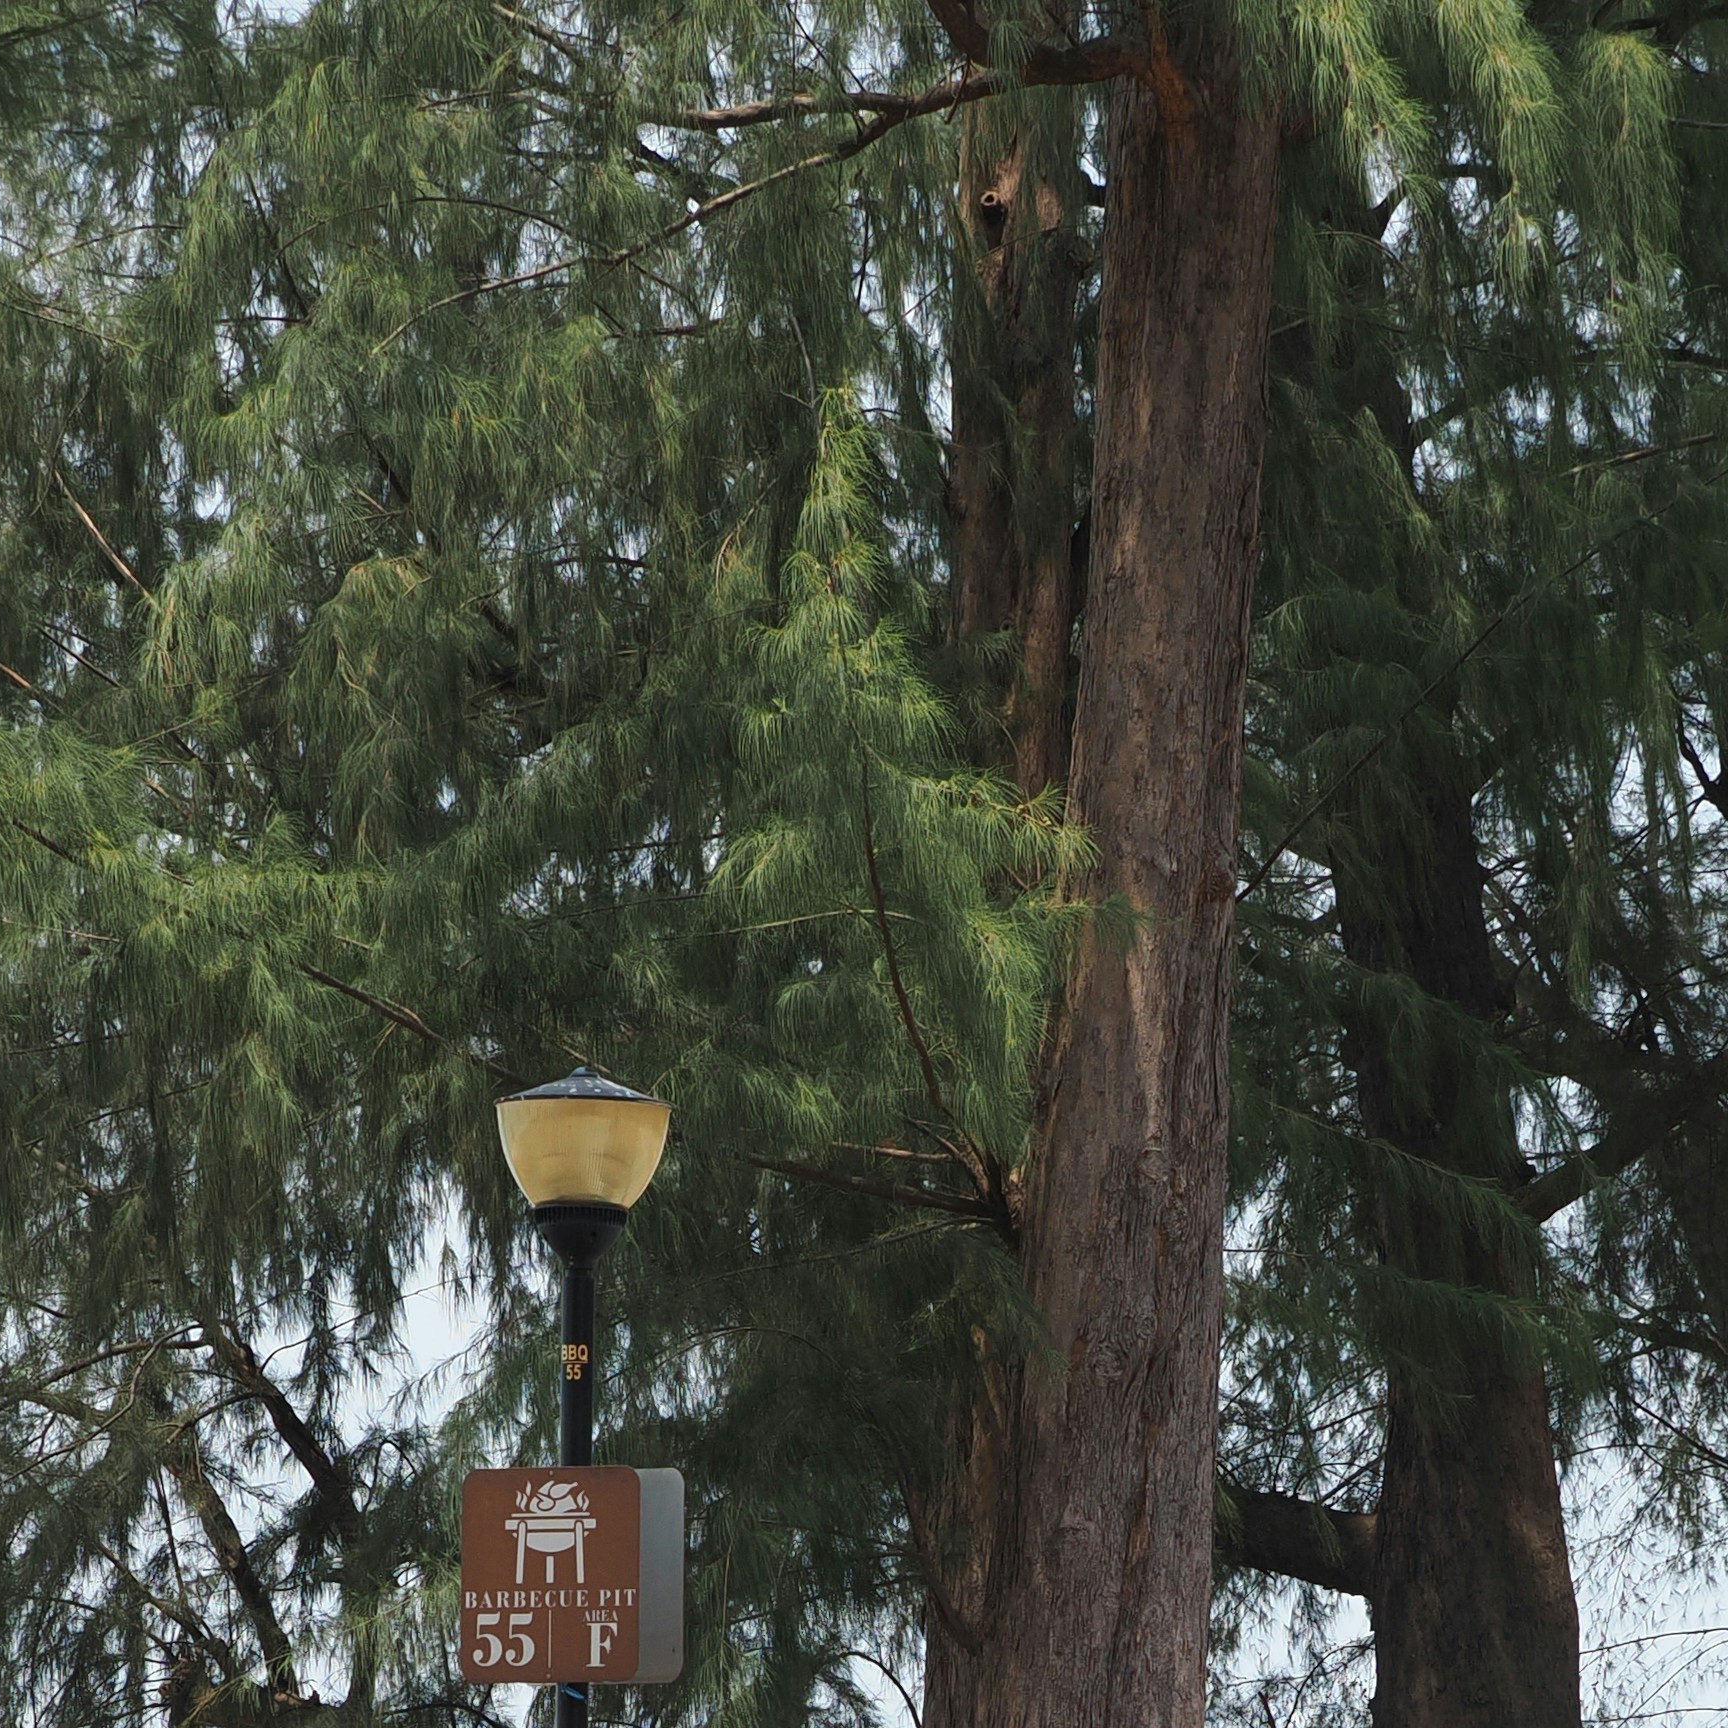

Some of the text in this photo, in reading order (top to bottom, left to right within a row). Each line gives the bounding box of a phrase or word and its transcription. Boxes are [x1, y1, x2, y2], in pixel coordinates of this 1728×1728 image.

[561, 1344, 588, 1361] BBQ
[566, 1364, 581, 1380] 55
[465, 1589, 636, 1608] BARBECUE PIT
[584, 1609, 618, 1621] AREA
[472, 1611, 535, 1667] 55
[585, 1622, 618, 1667] F
